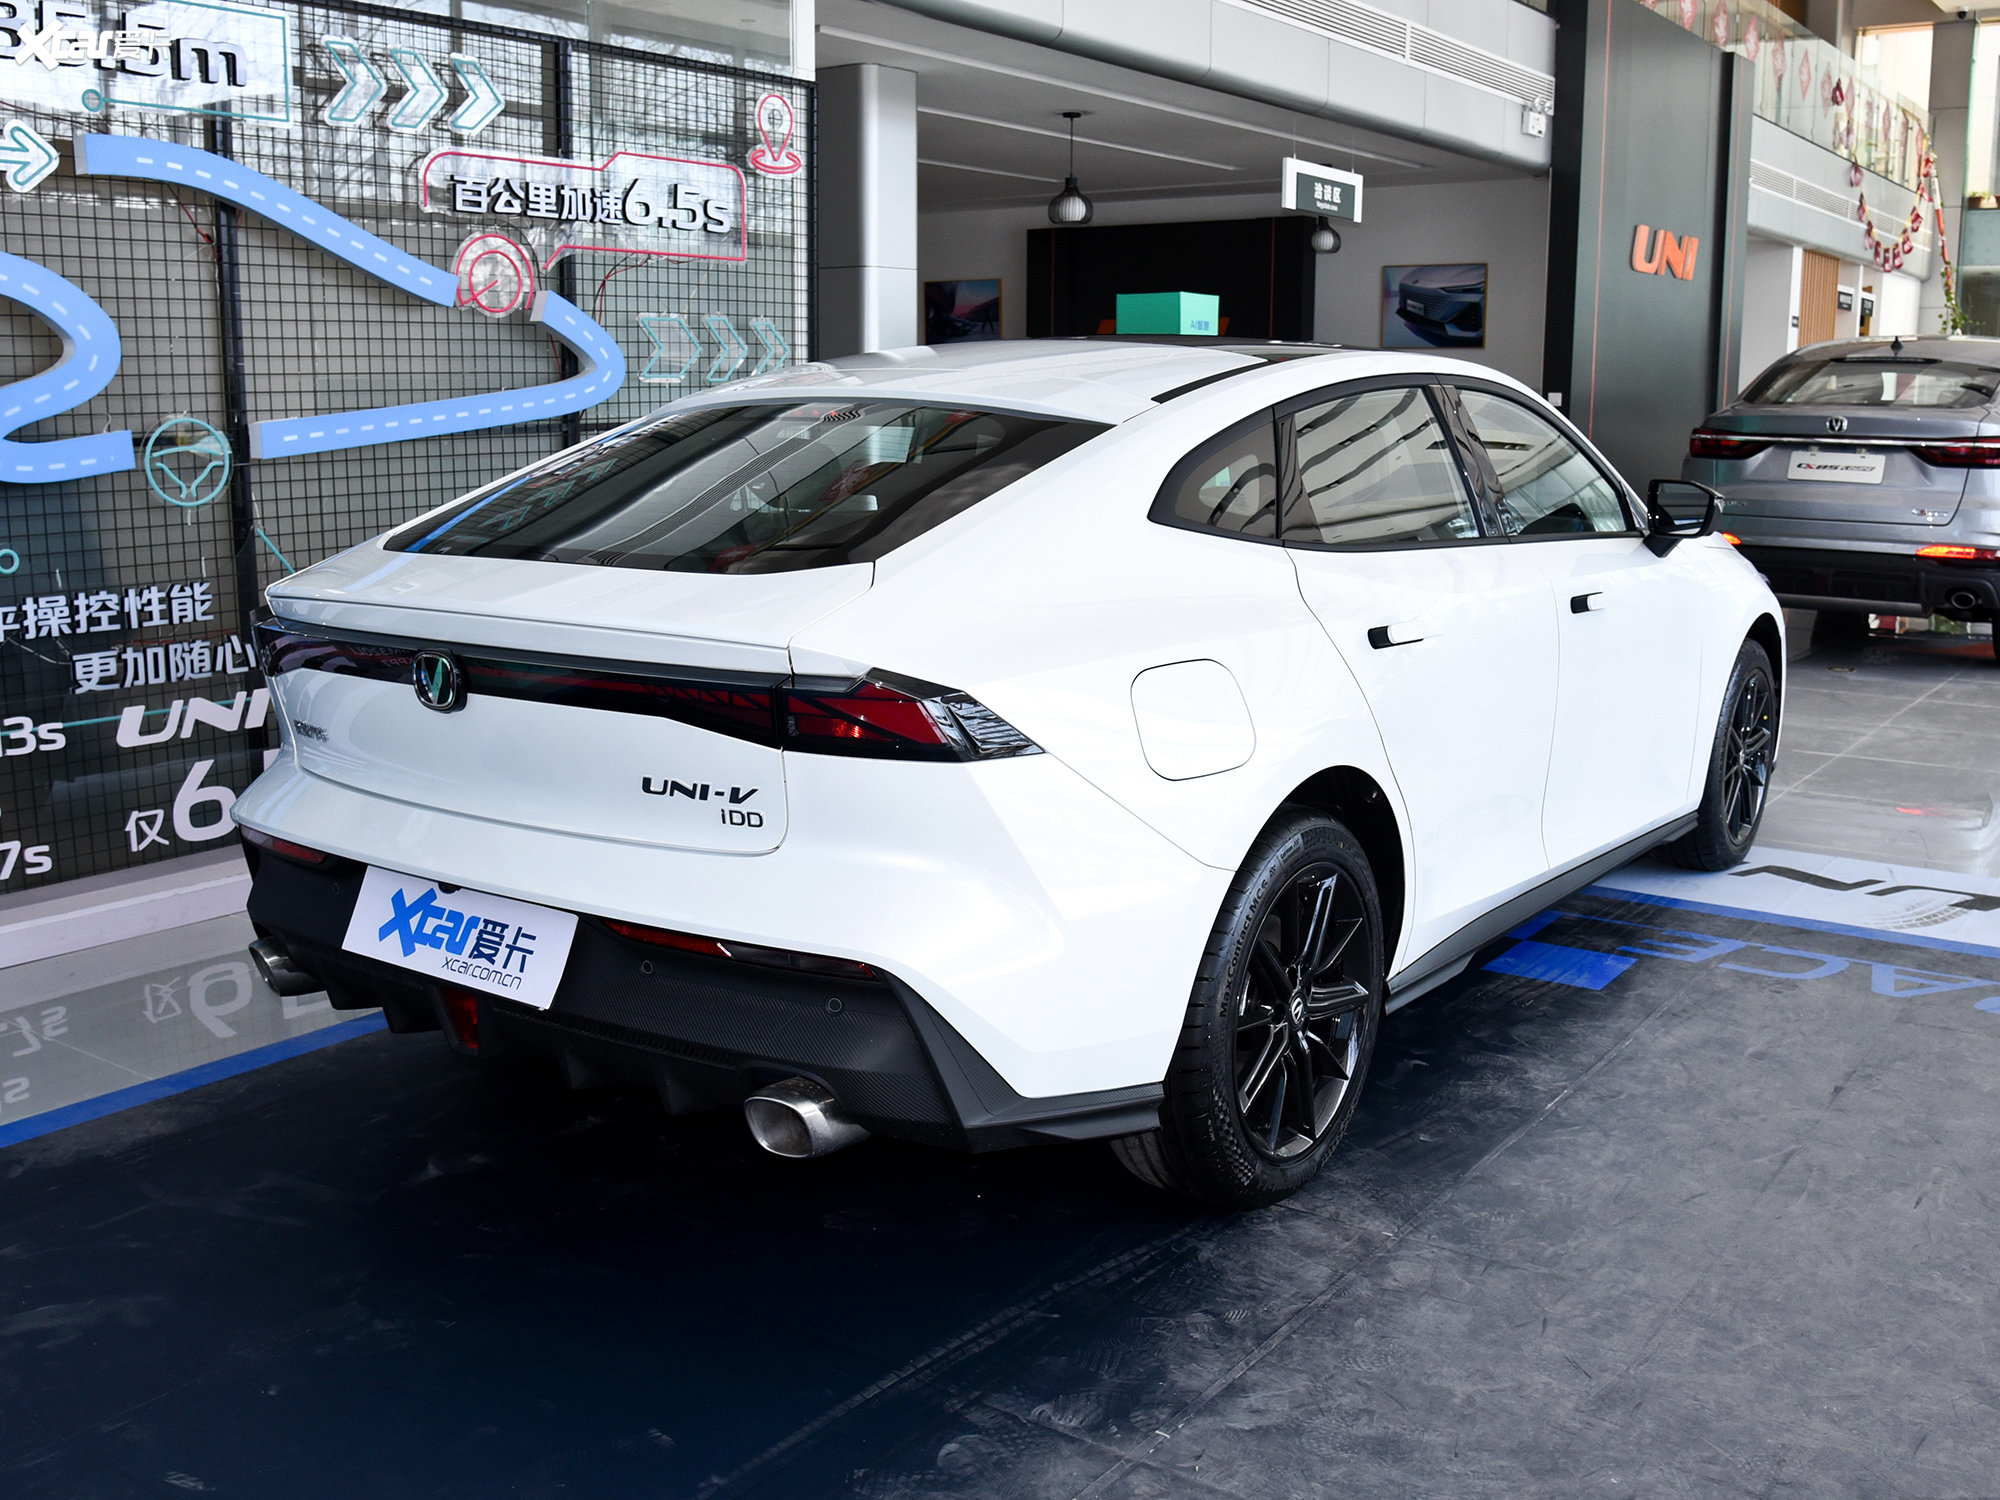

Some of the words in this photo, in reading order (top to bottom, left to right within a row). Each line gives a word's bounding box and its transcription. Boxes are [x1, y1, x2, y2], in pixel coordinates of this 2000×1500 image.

[1631, 223, 1700, 281] UNI
[642, 776, 759, 804] UNI-V
[720, 808, 764, 828] iDD
